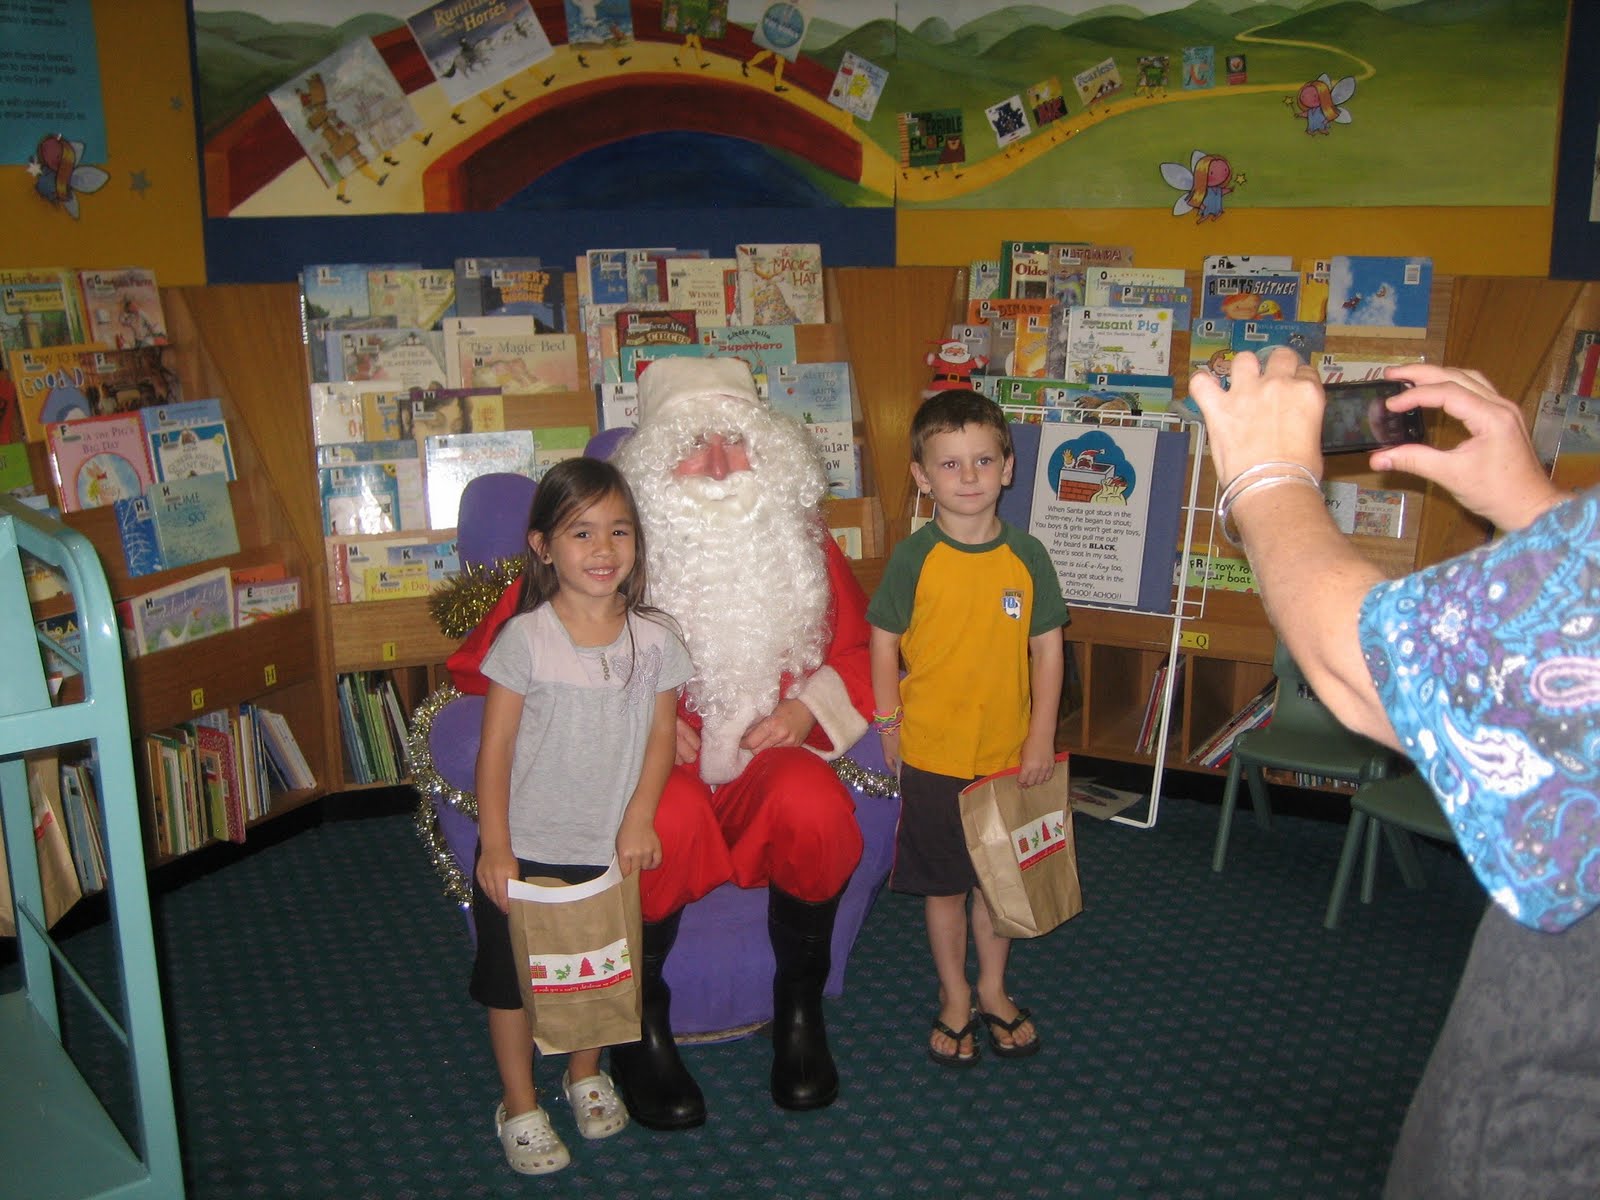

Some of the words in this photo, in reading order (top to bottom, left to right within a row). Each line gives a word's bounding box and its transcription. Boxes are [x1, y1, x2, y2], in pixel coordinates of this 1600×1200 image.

[463, 2, 506, 31] Horses
[773, 258, 811, 272] MAGIC
[793, 272, 818, 286] HAT
[1253, 280, 1297, 296] SLITHER
[688, 291, 720, 299] WINNIE
[1149, 293, 1188, 303] EASTER
[1137, 320, 1160, 333] Pig
[498, 340, 536, 354] Magic
[541, 340, 567, 352] Bed
[718, 341, 782, 352] Superhero
[816, 425, 829, 434] Fox
[1047, 505, 1065, 513] When
[1066, 506, 1084, 514] Santa
[1084, 508, 1095, 516] got
[1096, 508, 1112, 516] stuck
[1113, 509, 1120, 517] in
[1045, 513, 1074, 523] chim-ney,
[1084, 517, 1103, 525] began
[1047, 522, 1062, 530] boys
[1069, 524, 1082, 532] girls
[1083, 525, 1101, 533] won't
[1082, 533, 1094, 541] pull
[1053, 539, 1062, 547] My
[1088, 542, 1117, 551] BLACK,
[1049, 548, 1070, 556] there's
[1085, 550, 1091, 558] in
[1092, 551, 1103, 559] my
[1103, 553, 1119, 561] sack,
[1058, 570, 1076, 578] Santa
[1088, 573, 1105, 581] stuck
[1113, 575, 1124, 583] the
[1227, 571, 1251, 584] boat
[1064, 588, 1092, 597] ACHOO!
[1196, 636, 1207, 648] Q
